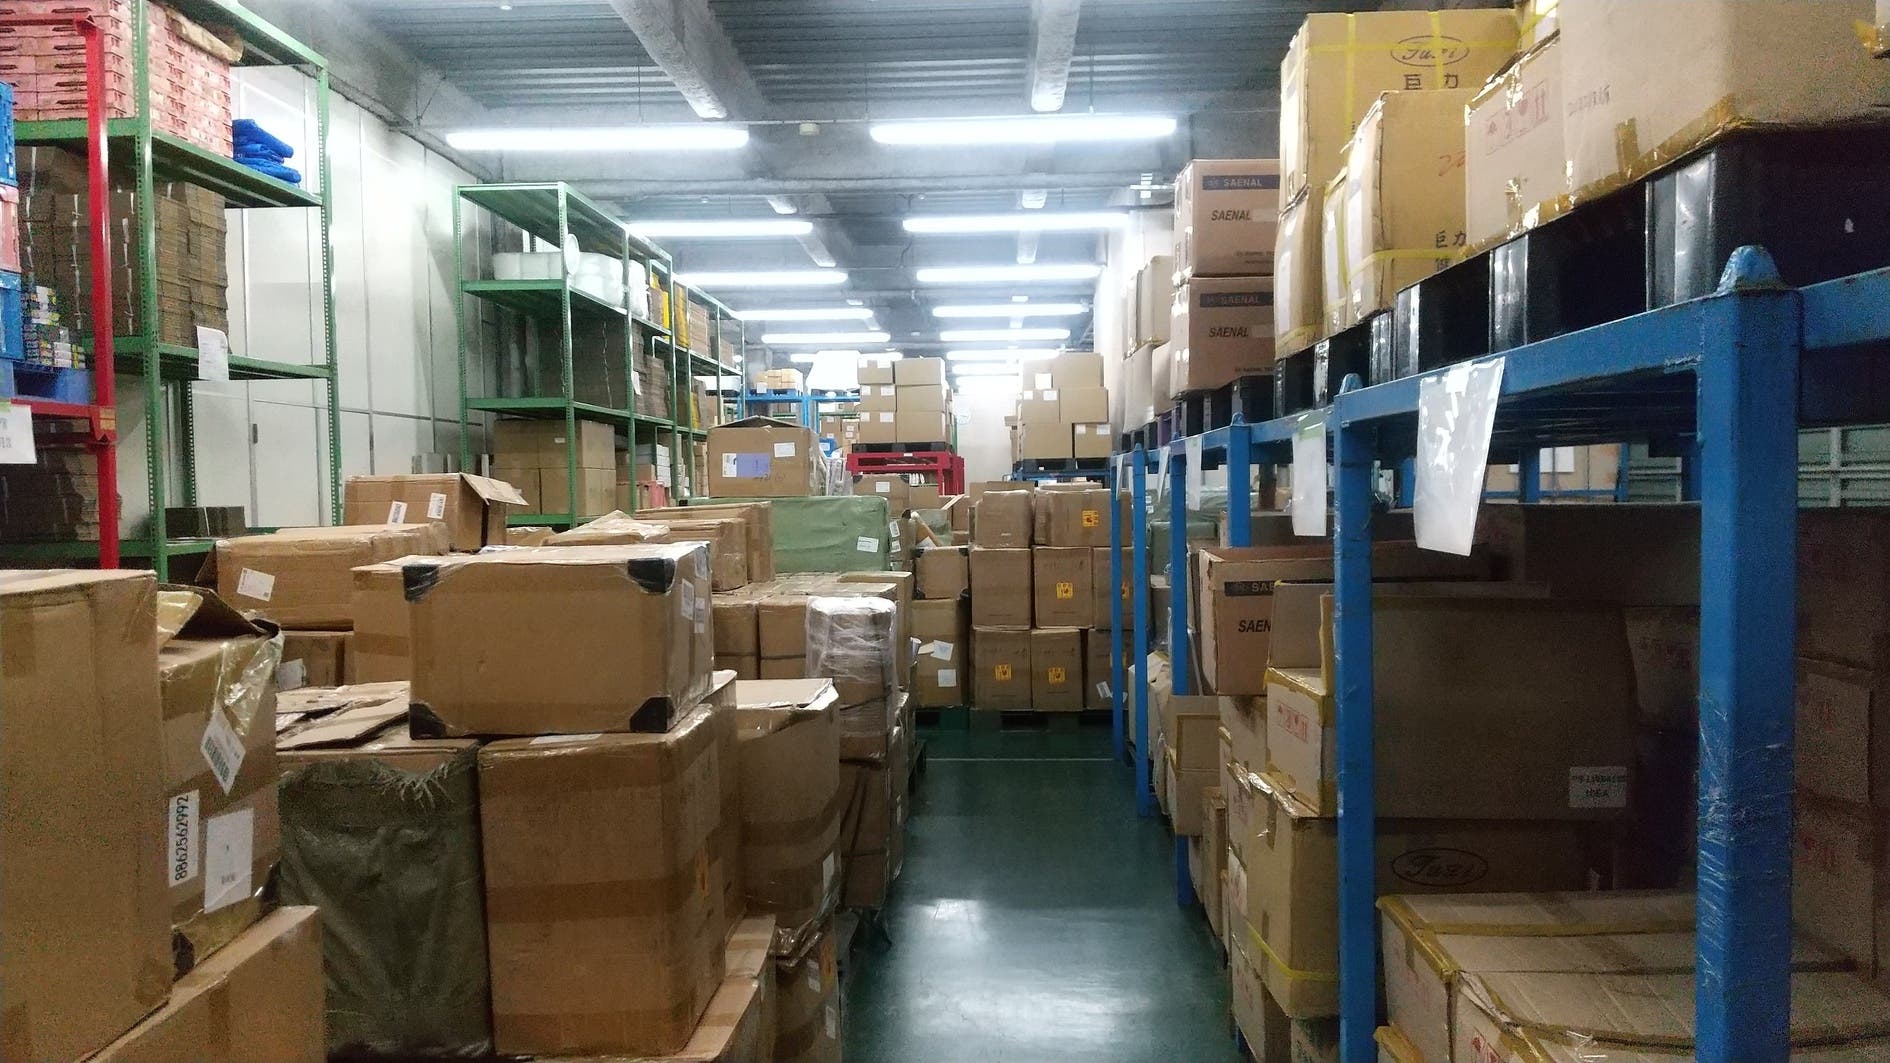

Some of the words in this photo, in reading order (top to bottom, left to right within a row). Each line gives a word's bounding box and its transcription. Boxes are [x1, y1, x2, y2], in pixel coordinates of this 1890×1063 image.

[1403, 73, 1459, 91] 巨力
[1223, 178, 1262, 187] SAENAL
[1211, 209, 1253, 221] SAENAL
[1435, 229, 1467, 249] 巨力
[1208, 327, 1249, 338] SAENAL
[174, 795, 189, 880] 8862562992
